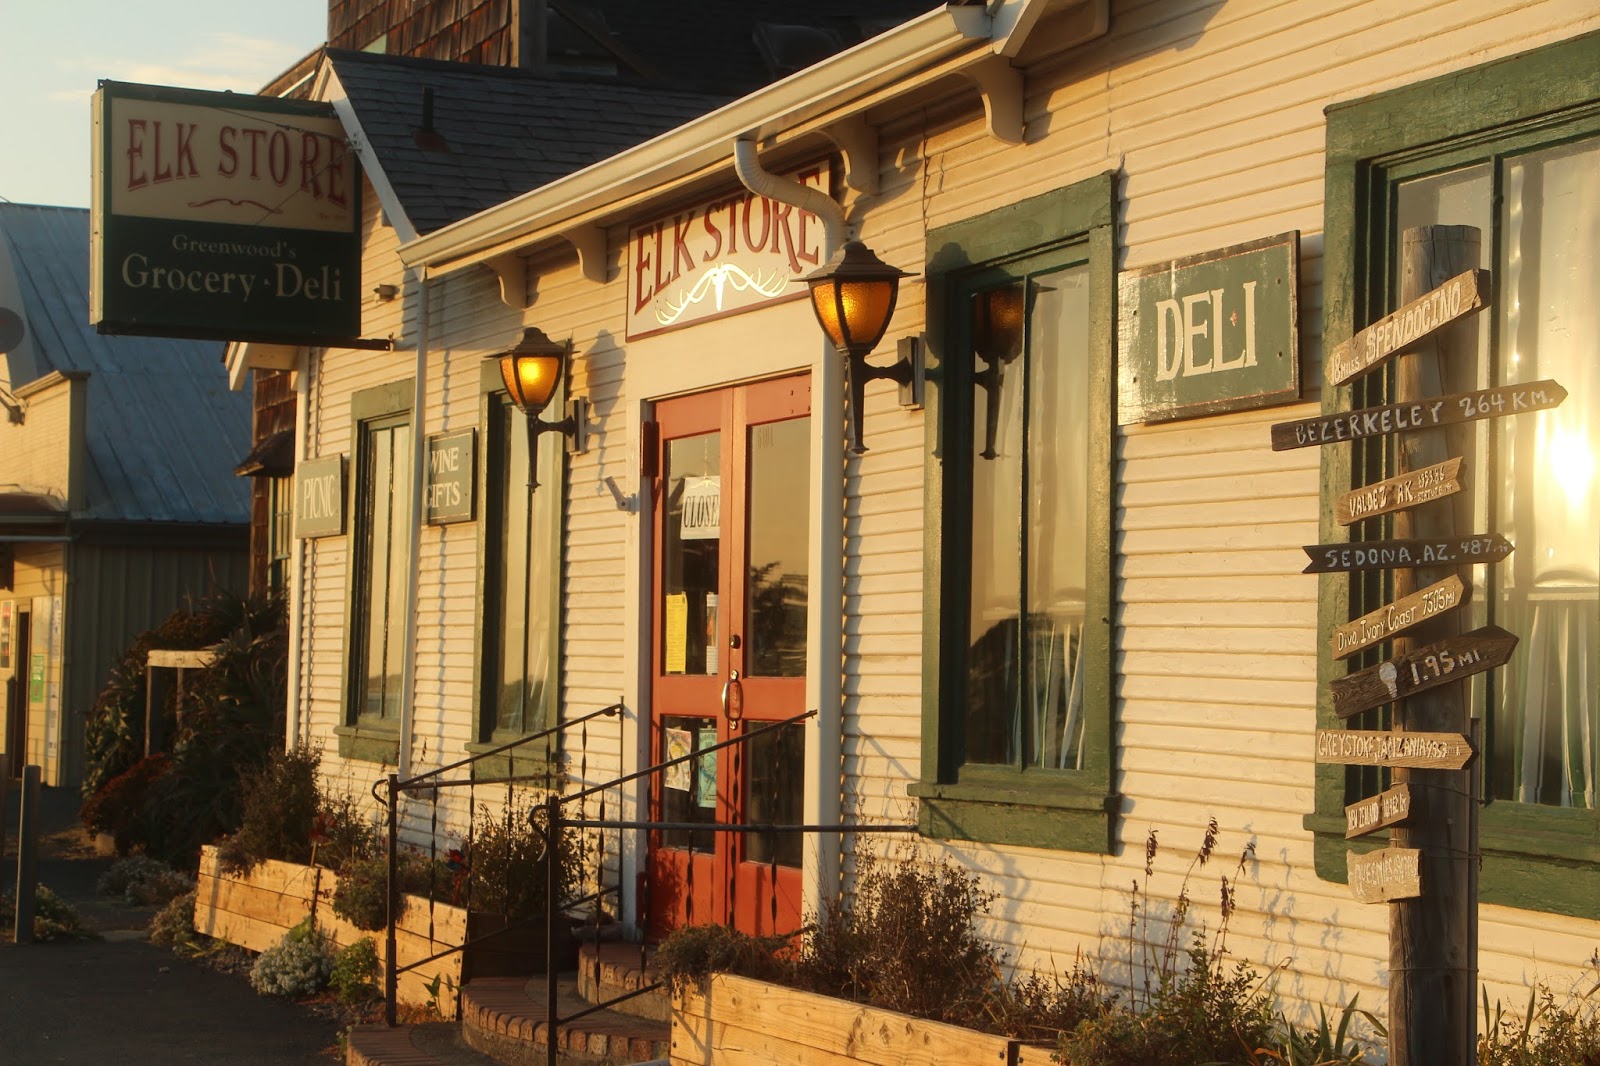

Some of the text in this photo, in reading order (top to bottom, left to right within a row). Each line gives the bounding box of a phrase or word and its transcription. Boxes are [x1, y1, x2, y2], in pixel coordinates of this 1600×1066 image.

[127, 118, 348, 210] ELK STORE
[172, 233, 297, 259] Greenwood's
[634, 168, 820, 315] ELK STORE
[121, 253, 344, 303] Grocery Deli
[1156, 280, 1258, 382] DELI
[1295, 389, 1556, 445] BEZERKELEY 264 KM.
[302, 474, 336, 520] PICNIC
[424, 481, 462, 509] GIFTS
[684, 495, 720, 528] CLOSE
[1349, 486, 1388, 518] VALDEZ
[1410, 649, 1455, 686] 1.95
